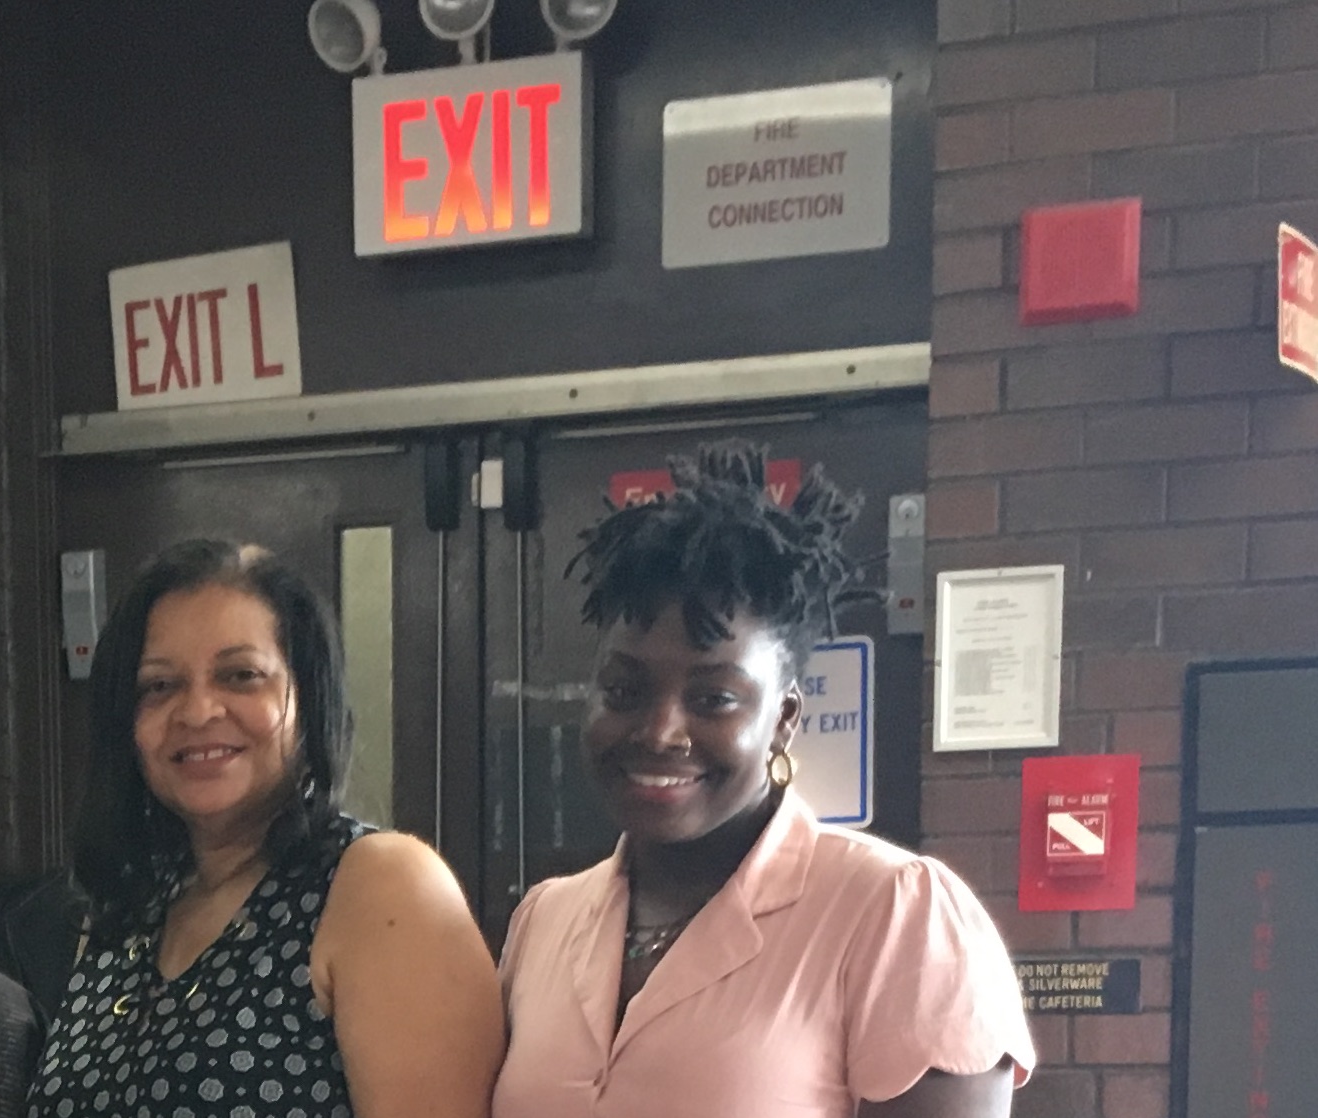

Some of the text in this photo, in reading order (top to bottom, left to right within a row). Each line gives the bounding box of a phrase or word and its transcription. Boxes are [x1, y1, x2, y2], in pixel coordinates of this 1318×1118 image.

[754, 116, 800, 142] FIRE
[382, 83, 561, 243] EXIT
[706, 150, 848, 188] DEPARTMENT
[708, 192, 844, 229] CONNECTION
[124, 283, 284, 396] EXIT L
[804, 676, 827, 696] SE
[820, 711, 859, 733] EXIT
[1036, 963, 1059, 977] NOT
[1061, 962, 1109, 976] REMOVE
[1029, 977, 1102, 991] SILVERWARE
[1038, 995, 1103, 1009] CAFETERIA
